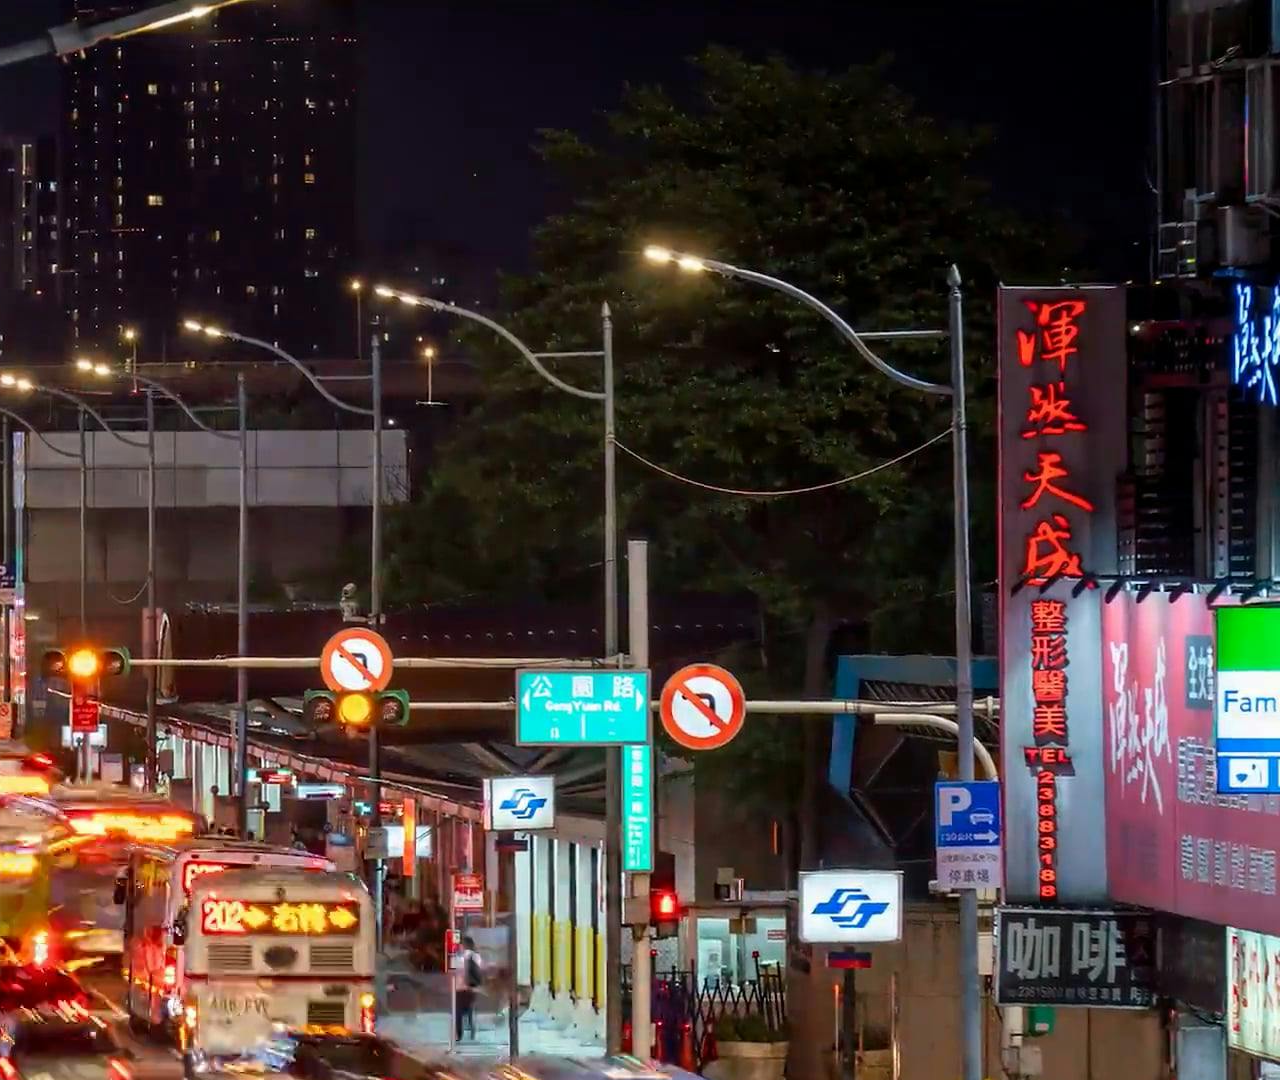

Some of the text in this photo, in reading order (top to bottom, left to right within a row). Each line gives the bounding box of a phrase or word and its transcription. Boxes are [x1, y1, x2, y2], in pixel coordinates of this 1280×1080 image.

[1031, 600, 1068, 736] 整形醫美
[530, 675, 635, 698] 公園路
[1025, 748, 1071, 764] TEL
[938, 787, 972, 826] P
[948, 869, 990, 885] 停車場
[203, 900, 244, 932] 202
[1006, 917, 1127, 984] 咖啡
